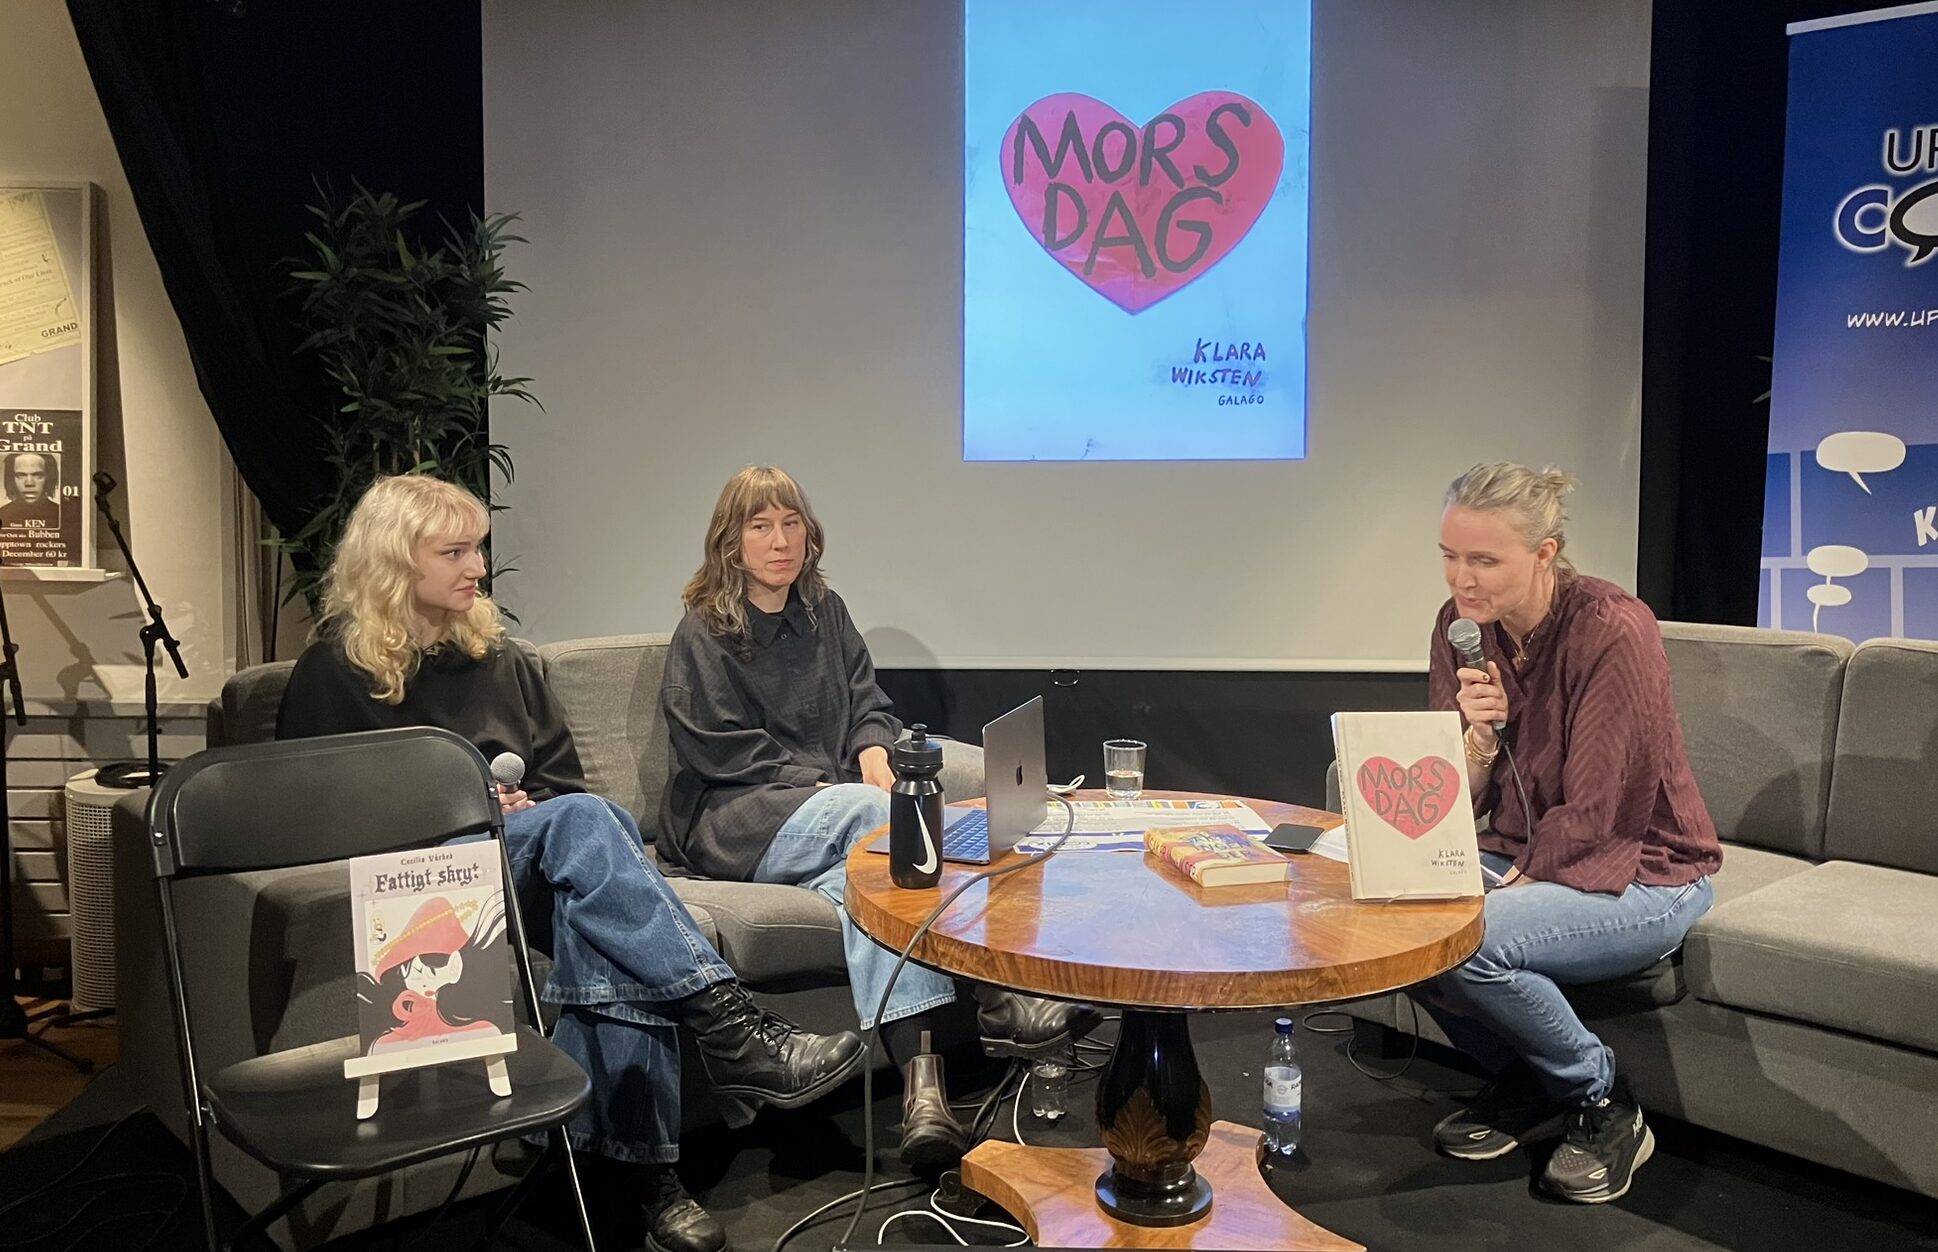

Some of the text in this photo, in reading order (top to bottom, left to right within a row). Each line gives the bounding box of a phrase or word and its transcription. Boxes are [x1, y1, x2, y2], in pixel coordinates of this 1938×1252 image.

[1013, 102, 1252, 188] MORS
[1041, 182, 1225, 279] DAG
[41, 322, 78, 338] GRAND
[1193, 337, 1266, 364] KLARA
[1171, 366, 1262, 387] WIKSTEN
[1218, 394, 1265, 406] GALAGO
[14, 413, 42, 422] Club
[2, 421, 54, 434] TNT
[0, 439, 63, 452] Grand
[25, 519, 45, 528] KEN
[2, 550, 43, 558] December
[58, 550, 68, 558] kr
[1361, 759, 1446, 793] MORS
[1375, 790, 1441, 826] DAG
[1438, 848, 1465, 859] KLARA
[375, 867, 432, 893] Fattigt
